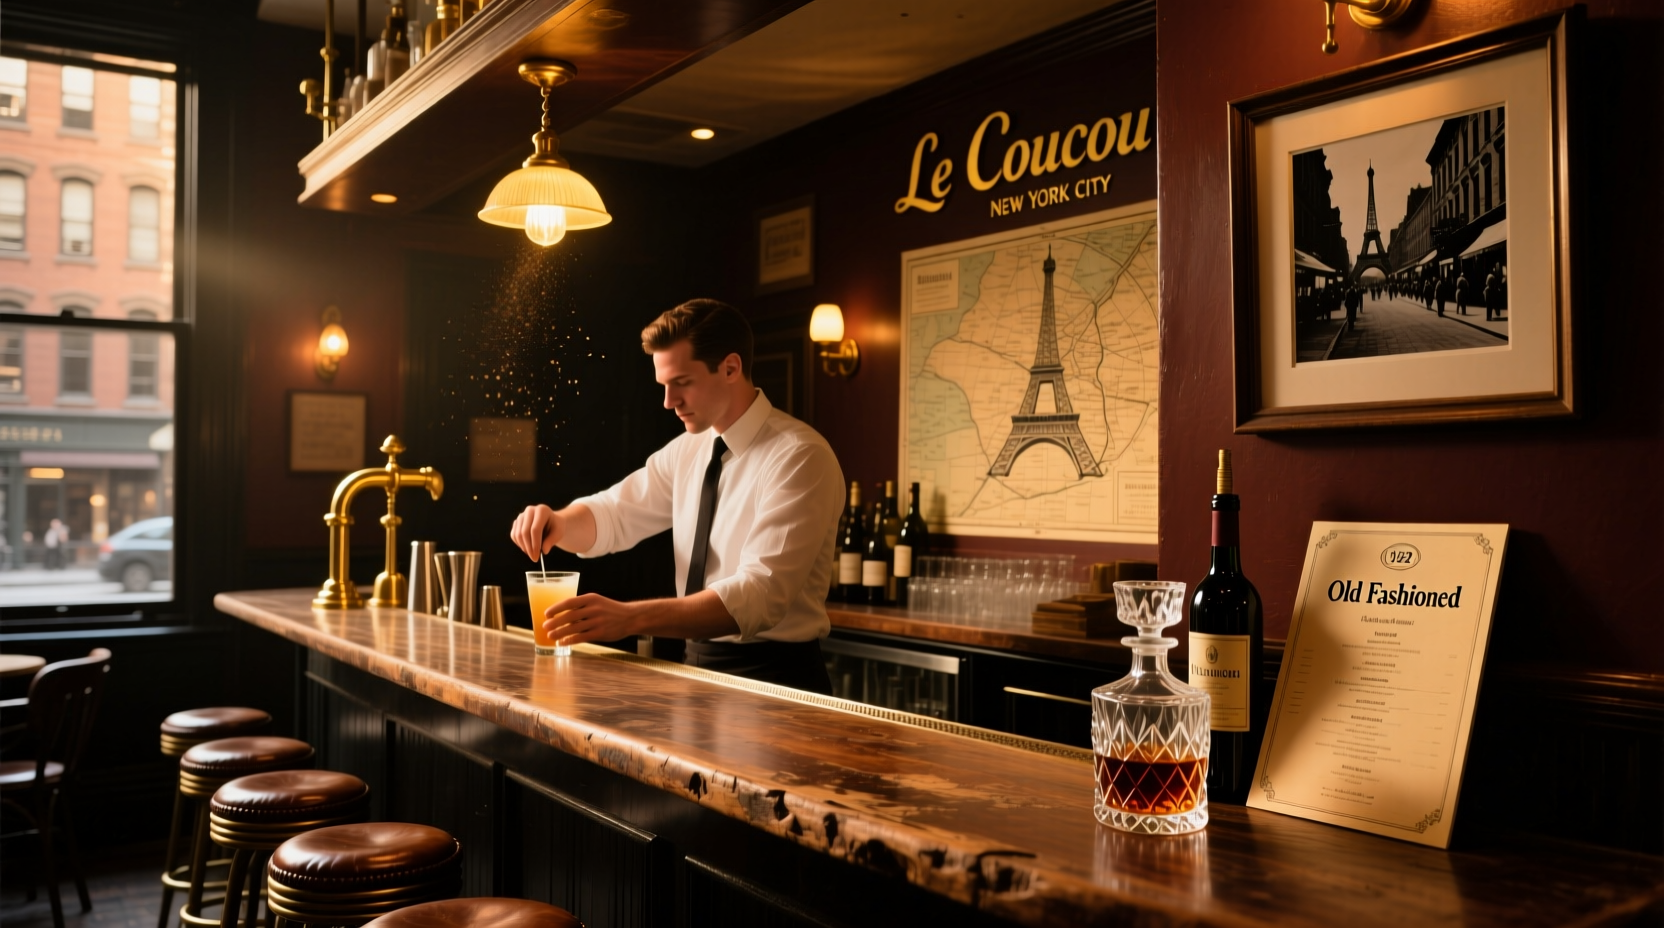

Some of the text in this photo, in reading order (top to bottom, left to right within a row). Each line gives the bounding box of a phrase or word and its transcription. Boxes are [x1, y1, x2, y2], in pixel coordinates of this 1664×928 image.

[894, 107, 1151, 213] Le Coucou
[990, 174, 1112, 218] NEW YORK CITY
[1327, 579, 1462, 608] Old Fashioned
